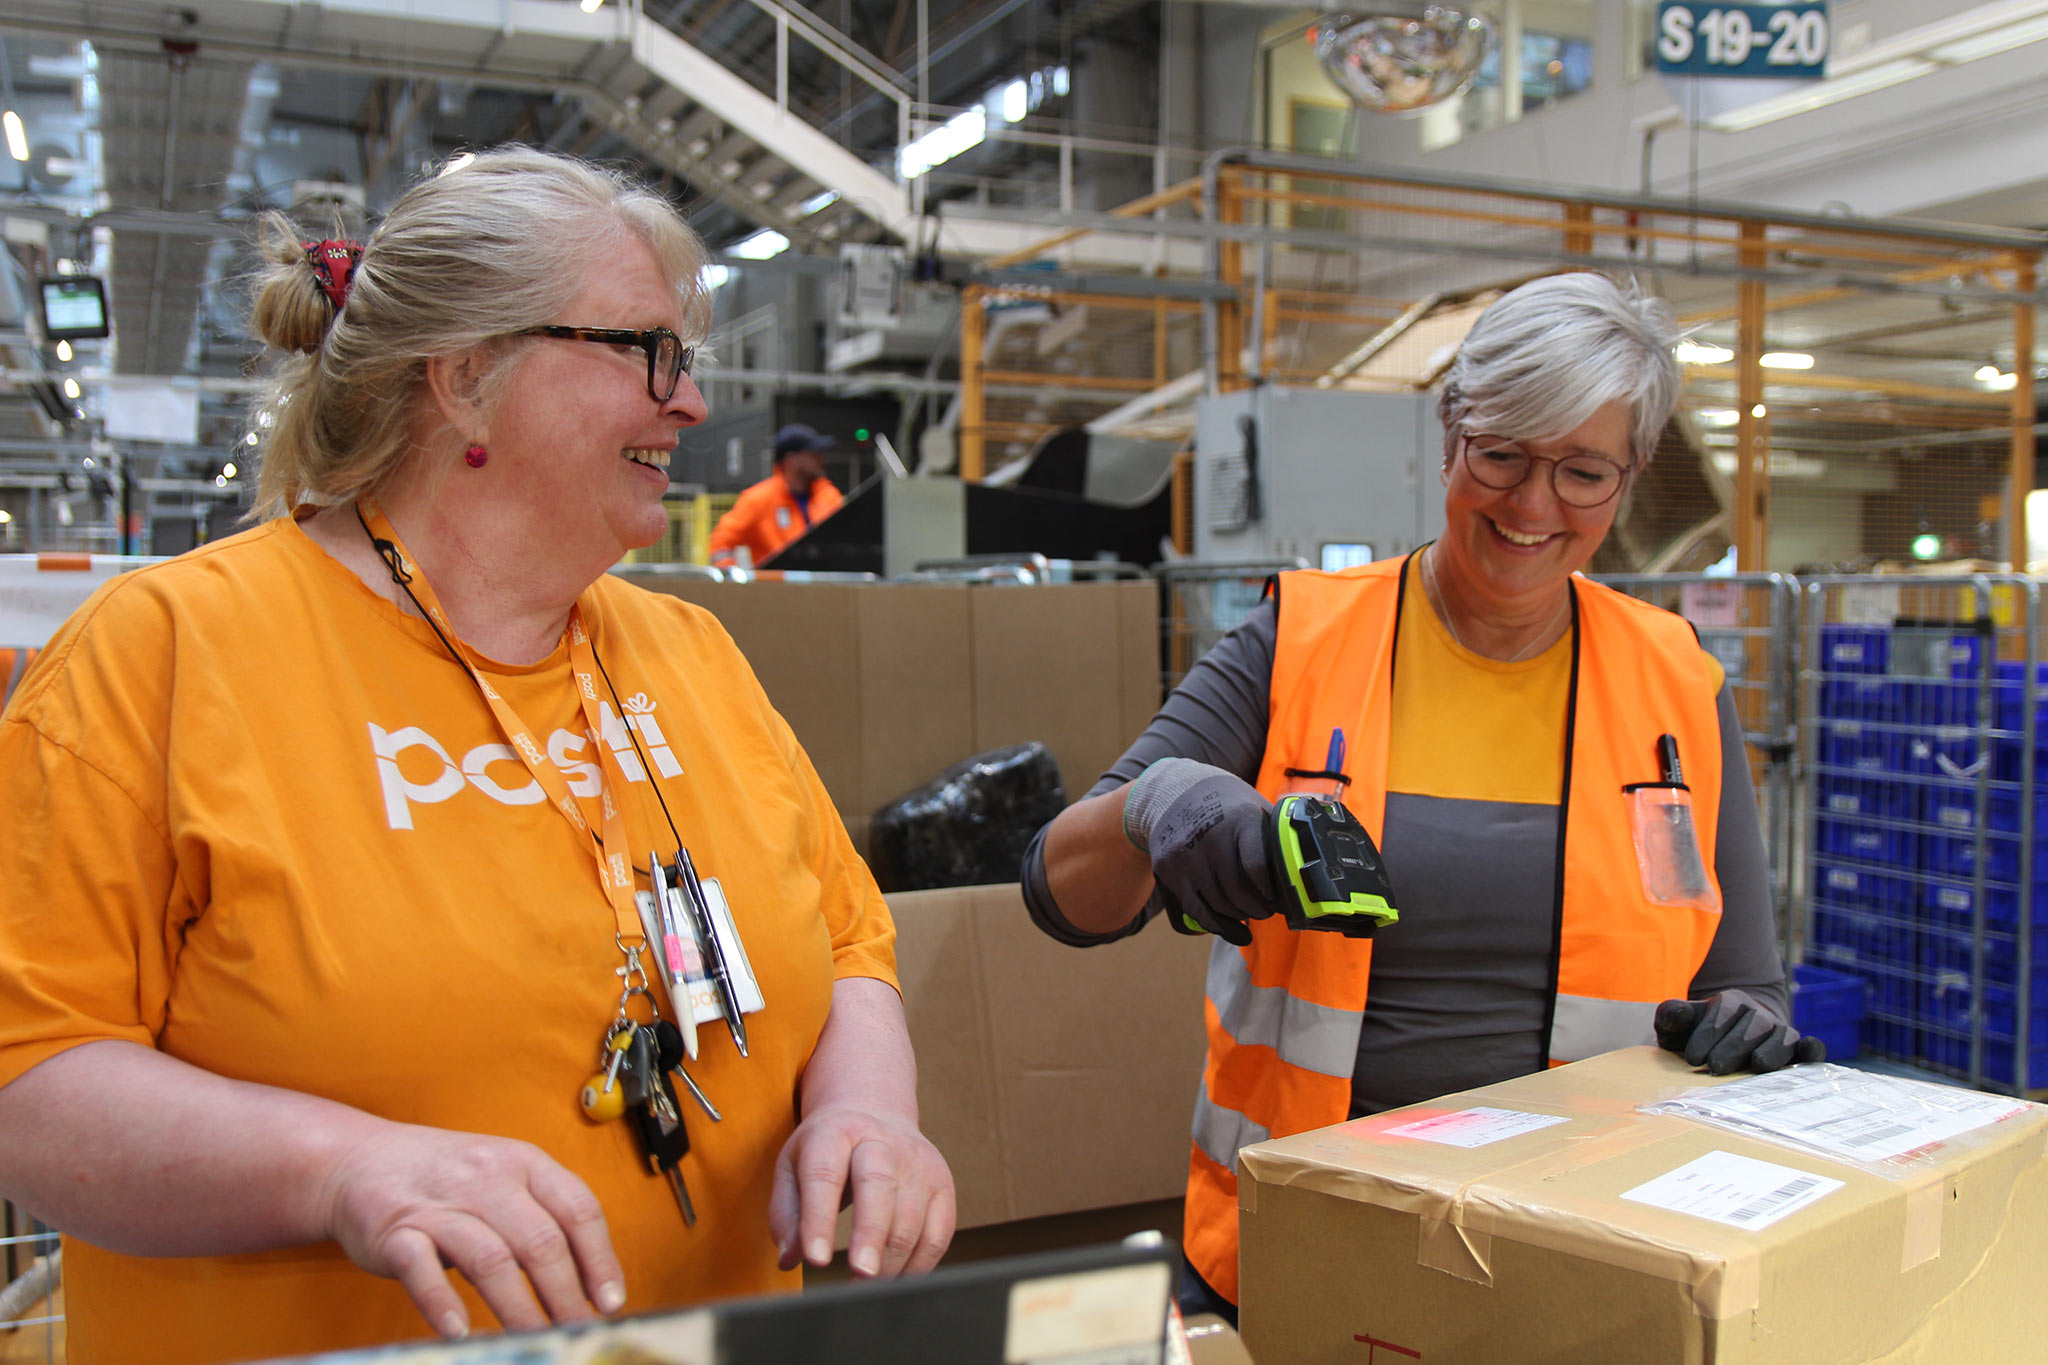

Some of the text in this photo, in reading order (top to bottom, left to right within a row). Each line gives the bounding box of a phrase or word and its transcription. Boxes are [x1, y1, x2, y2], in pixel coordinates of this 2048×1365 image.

[1658, 5, 1828, 67] S 19-20
[576, 672, 598, 702] posti
[367, 692, 685, 831] posti
[512, 731, 548, 767] posti
[607, 851, 632, 888] posti
